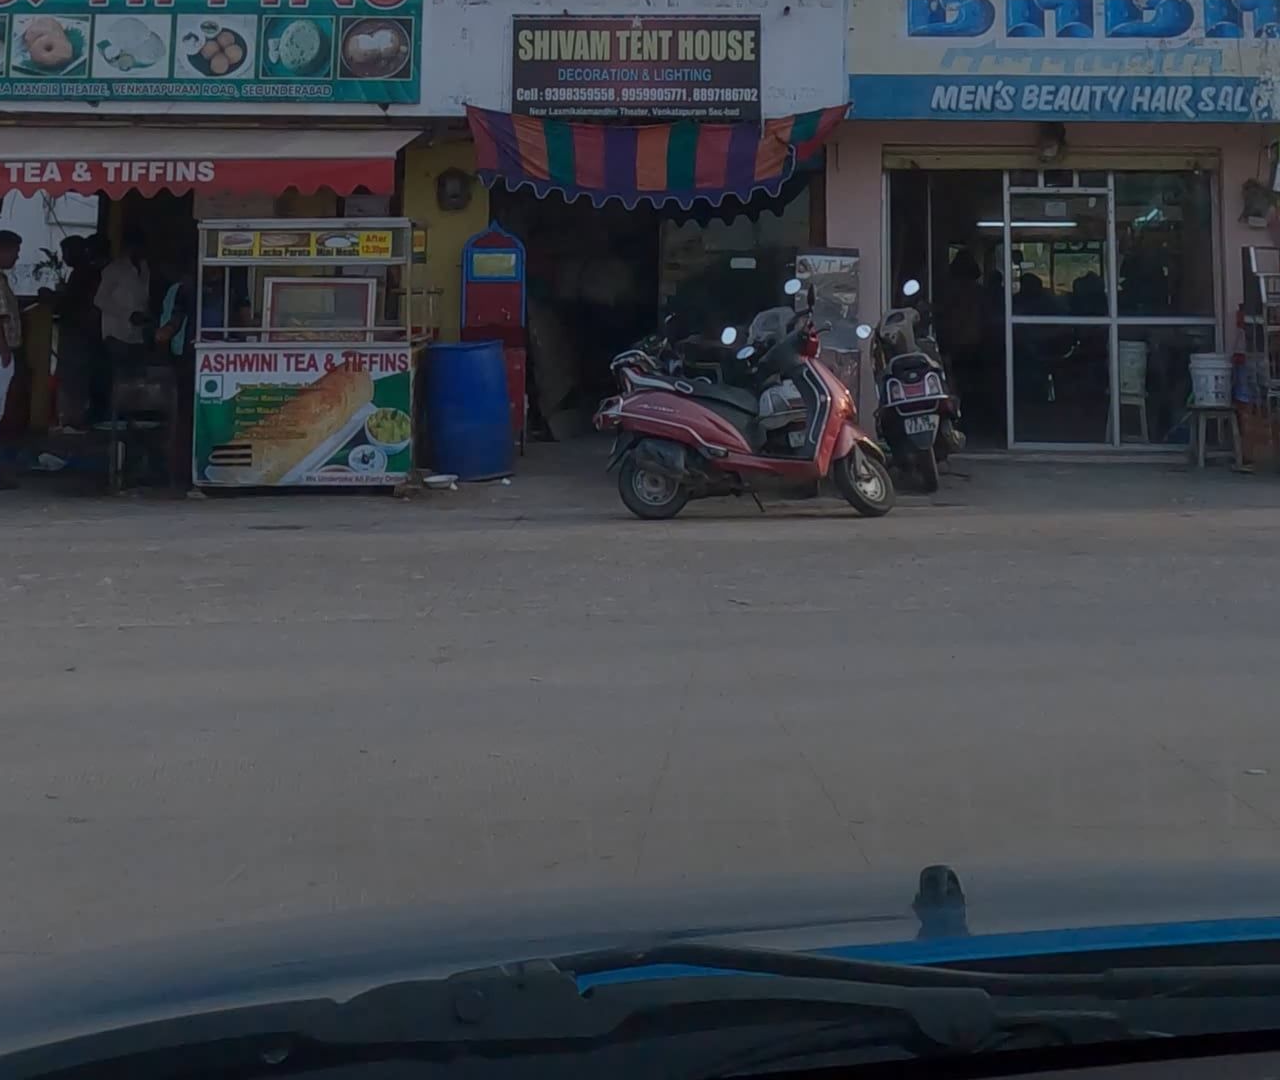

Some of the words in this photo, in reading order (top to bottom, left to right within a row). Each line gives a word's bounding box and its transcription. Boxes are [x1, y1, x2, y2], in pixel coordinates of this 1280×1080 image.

[518, 29, 611, 61] SHIVAM
[616, 30, 673, 61] TENT
[678, 29, 756, 61] HOUSE
[558, 69, 639, 81] DECORATION
[642, 69, 651, 81] &
[654, 69, 712, 81] LIGHTING
[13, 82, 59, 96] MANDIR
[61, 82, 110, 98] THEATRE,
[112, 83, 200, 97] VENKATAPURAM
[202, 83, 239, 98] ROAD,
[241, 83, 332, 97] SECUNDERABAD
[931, 80, 1014, 112] MEN'S
[1021, 81, 1121, 112] BEAUTY
[1131, 82, 1191, 112] HAIR
[529, 108, 547, 117] Near
[5, 162, 62, 183] TEA
[72, 162, 92, 183] &
[103, 161, 216, 183] TIFFINS
[200, 353, 278, 373] ASHWINI
[283, 353, 318, 373] TEA
[323, 353, 337, 373] &
[342, 352, 409, 373] TIFFINS
